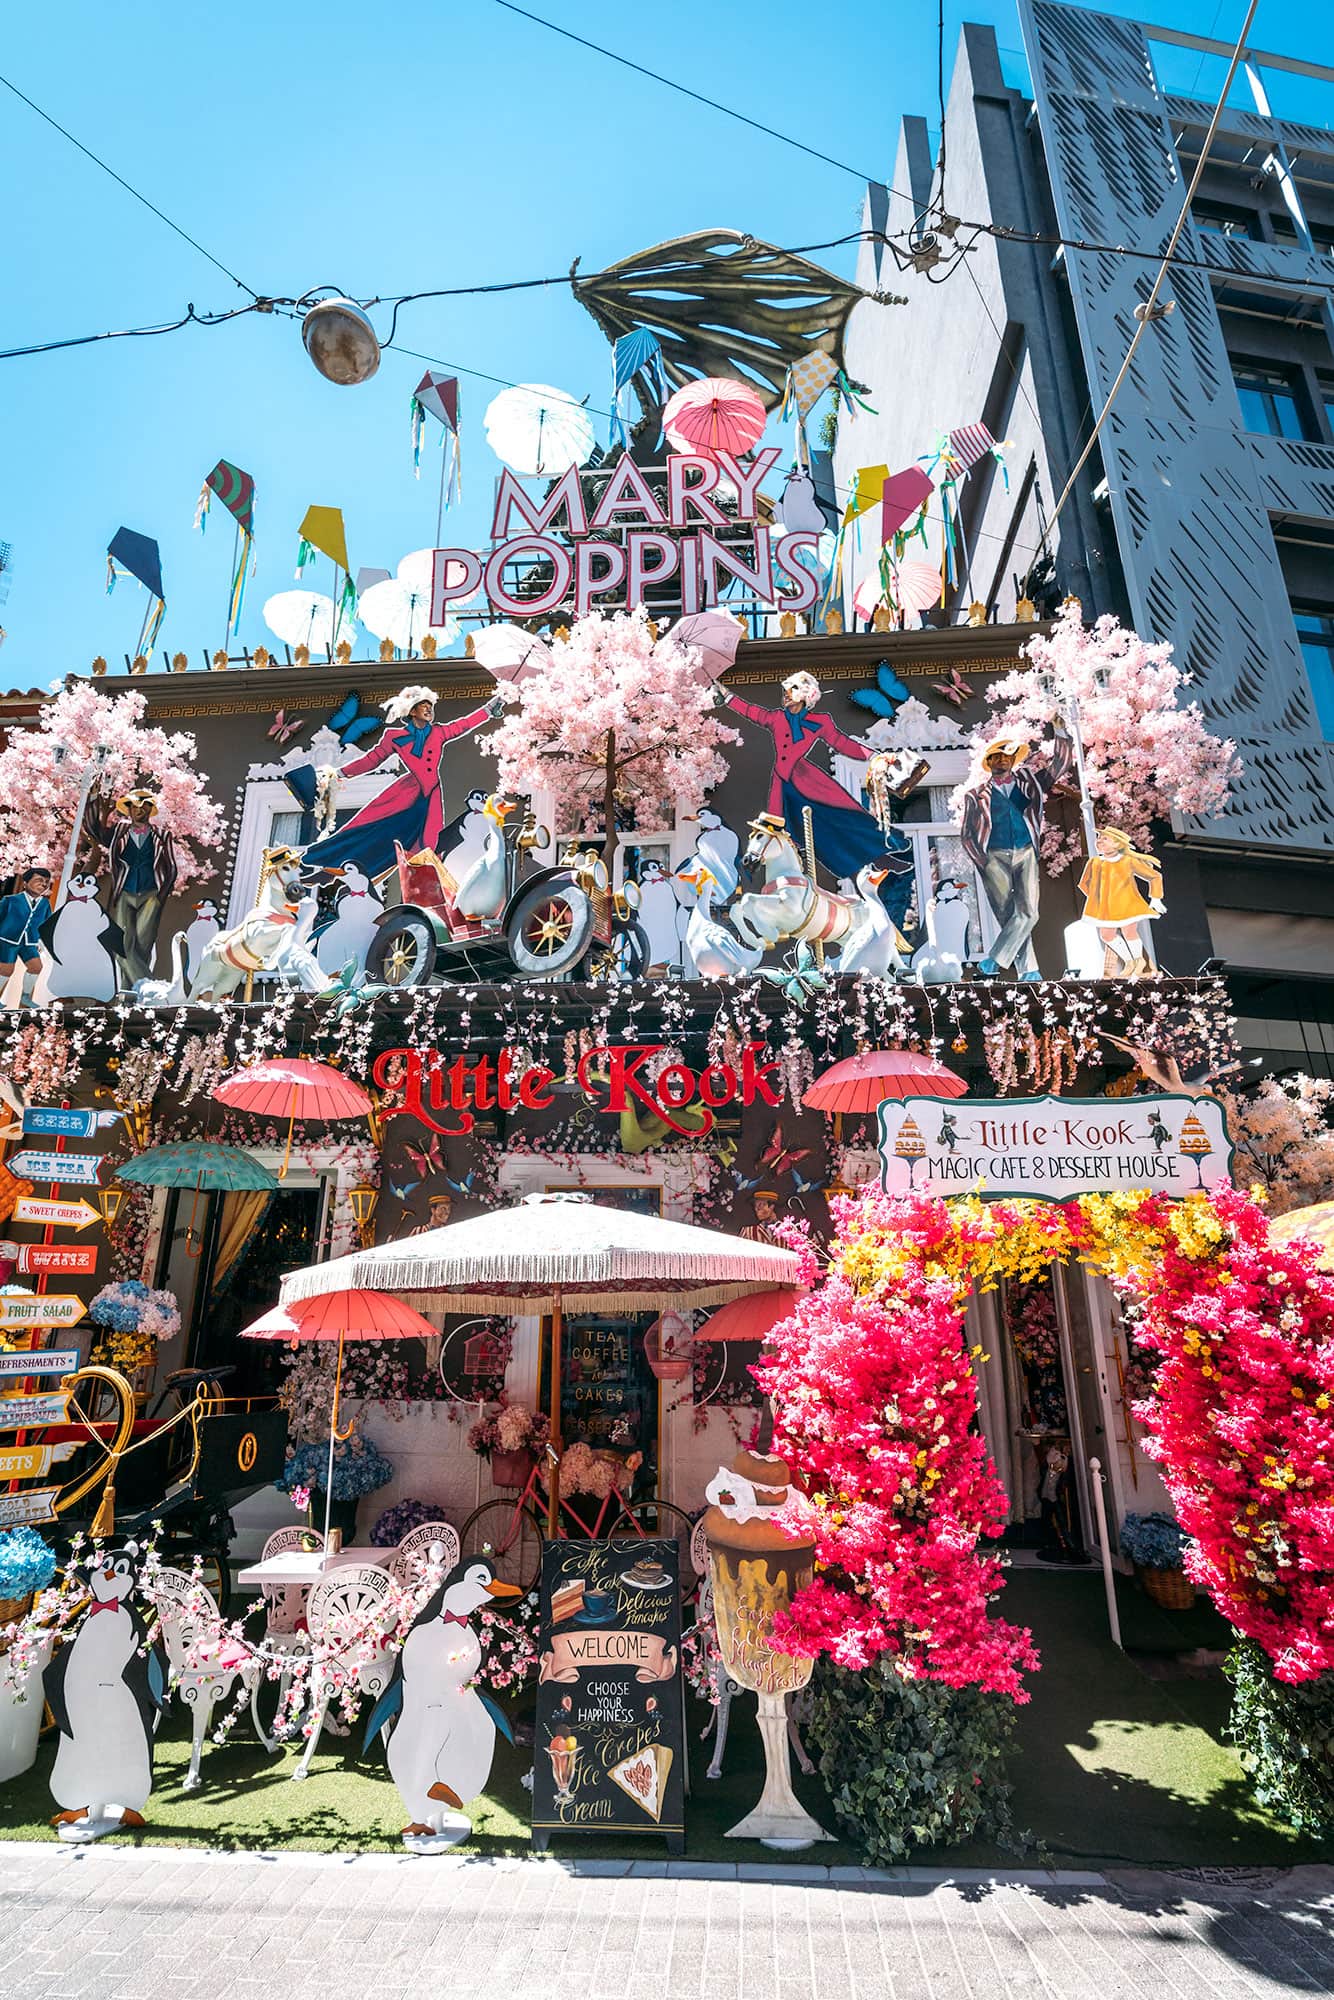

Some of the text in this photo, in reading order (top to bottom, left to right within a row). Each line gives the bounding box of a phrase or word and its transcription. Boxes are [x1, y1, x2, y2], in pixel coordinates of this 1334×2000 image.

[490, 448, 782, 540] MARY
[429, 526, 819, 628] POPPINS
[372, 1040, 785, 1137] Little Kook
[31, 1113, 84, 1130] BEER
[970, 1119, 1137, 1151] Little Kook
[26, 1160, 86, 1175] ICE TEA
[928, 1155, 1181, 1180] MAGIC CAFE & DESSERT HOUSE
[29, 1205, 83, 1219] SWEET CREPES
[32, 1252, 90, 1266] WINE
[8, 1304, 73, 1318] FRUIT SALAD
[584, 1330, 616, 1343] TEA
[572, 1347, 629, 1361] COFFEE
[561, 1548, 608, 1576] Coffee
[596, 1572, 624, 1592] Cake
[615, 1588, 673, 1616] Delicious
[620, 1606, 668, 1630] Pancakes
[567, 1635, 650, 1659] WELCOME
[586, 1681, 631, 1696] CHOOSE
[597, 1696, 623, 1709] YOUR
[578, 1708, 635, 1723] HAPPINESS
[595, 1720, 661, 1768] Crepes
[574, 1752, 600, 1793] Ice
[553, 1799, 615, 1825] Cream
